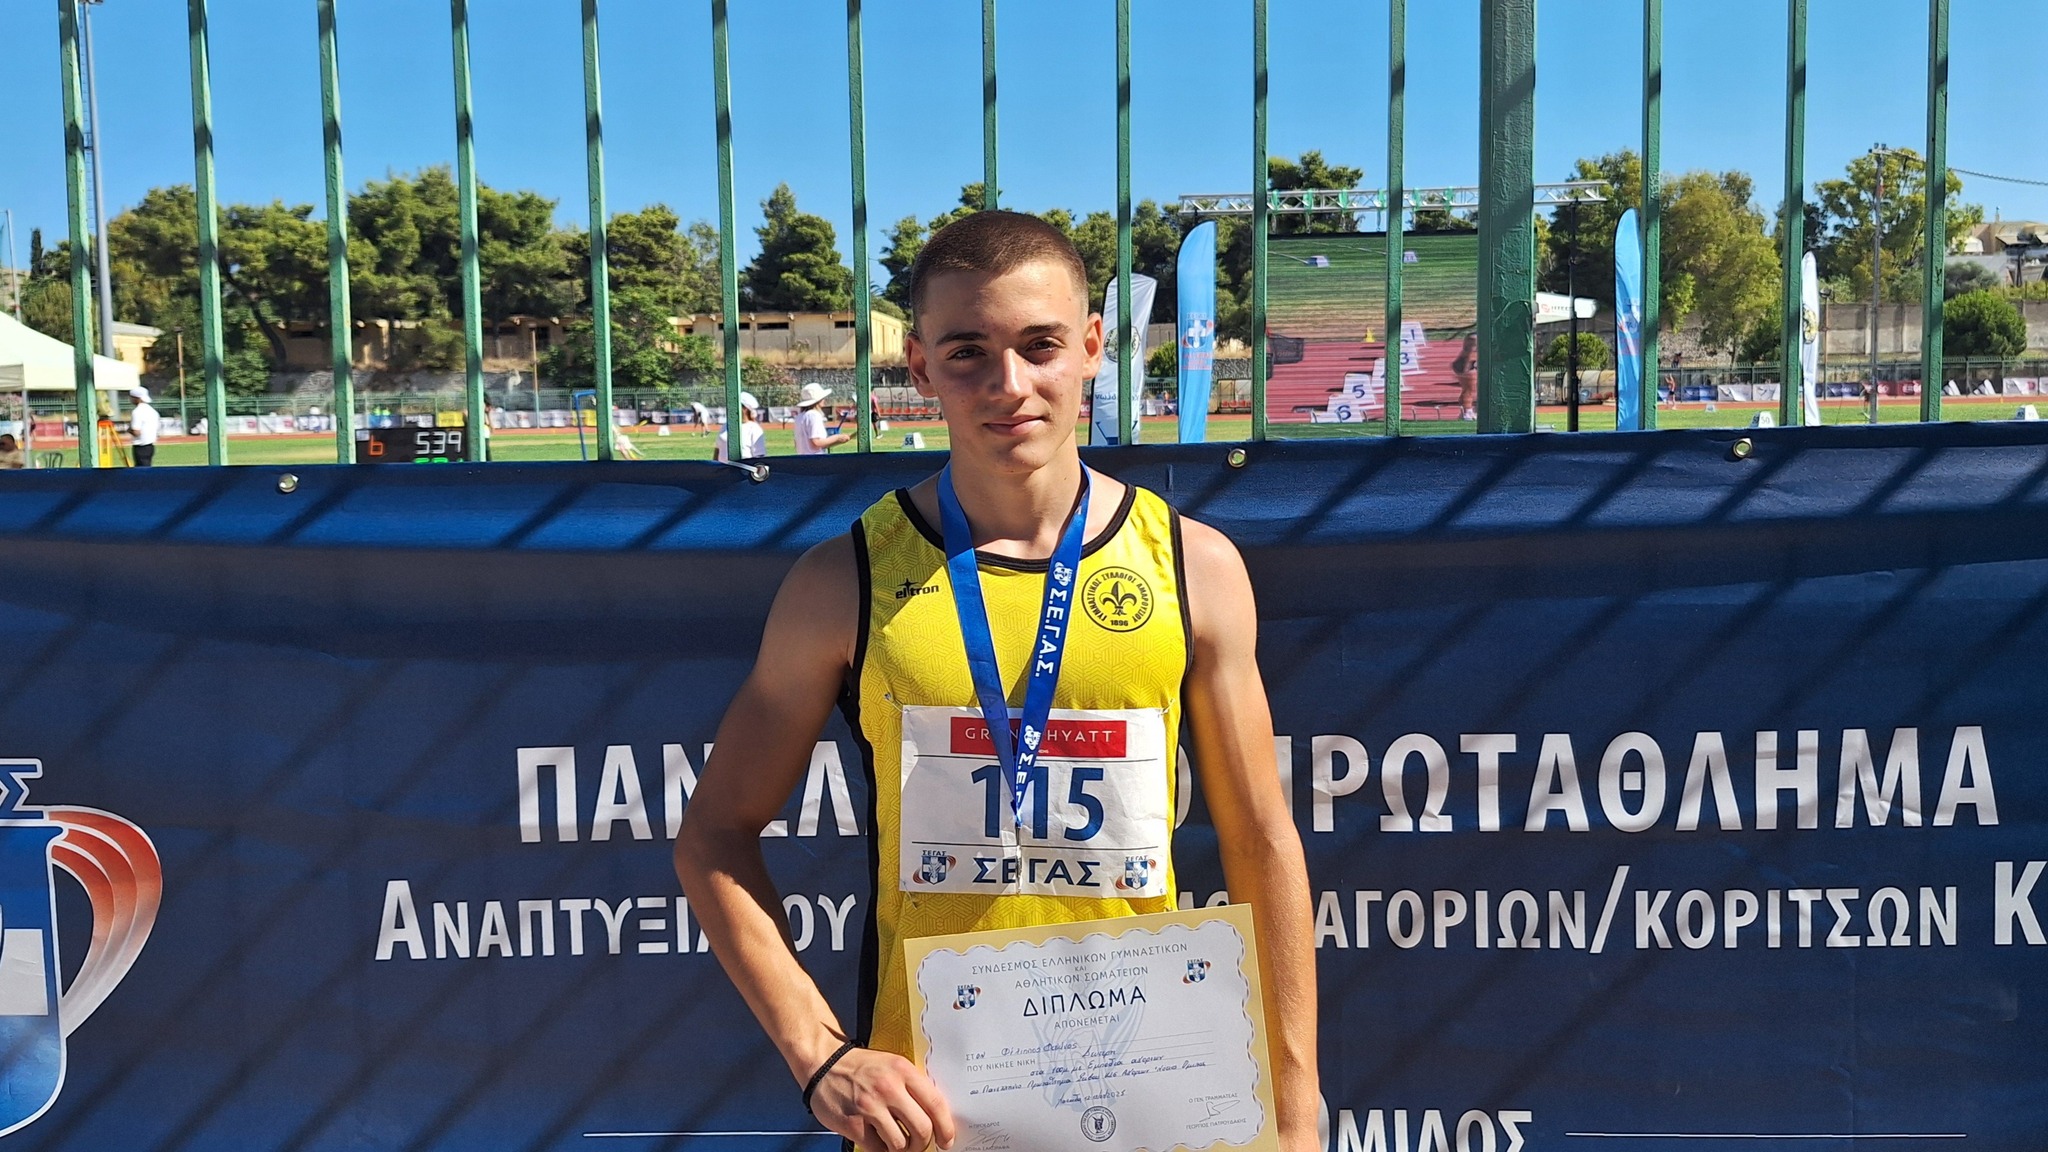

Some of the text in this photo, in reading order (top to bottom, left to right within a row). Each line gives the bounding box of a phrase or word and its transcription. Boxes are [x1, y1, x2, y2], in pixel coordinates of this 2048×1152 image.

[1047, 729, 1111, 743] HYATT
[970, 764, 1105, 842] 115
[971, 856, 1101, 888] ΣΕΓΑΣ
[375, 880, 857, 961] ΑΝΑΠΤΥΞΙΟΥ
[971, 943, 1188, 975] ΣΥΝΔΕΣΜΟΣ ΕΛΛΗΝΙΚΩΝ ΓΥΜΝΑΣΤΙΚΩΝ
[1014, 966, 1149, 989] ΑΘΛΗΤΙΚΩΝ ΣΩΜΑΤΕΙΩΝ
[1023, 985, 1147, 1017] ΔΙΠΛΩΜΑ
[1054, 1014, 1120, 1029] ΑΠΟΝΕΜΕΤΑΙ
[966, 1064, 983, 1073] ΠΟΥ
[1017, 1058, 1036, 1067] ΝΙΚΗ
[1318, 1091, 1533, 1152] ΜΙΛΟΣ
